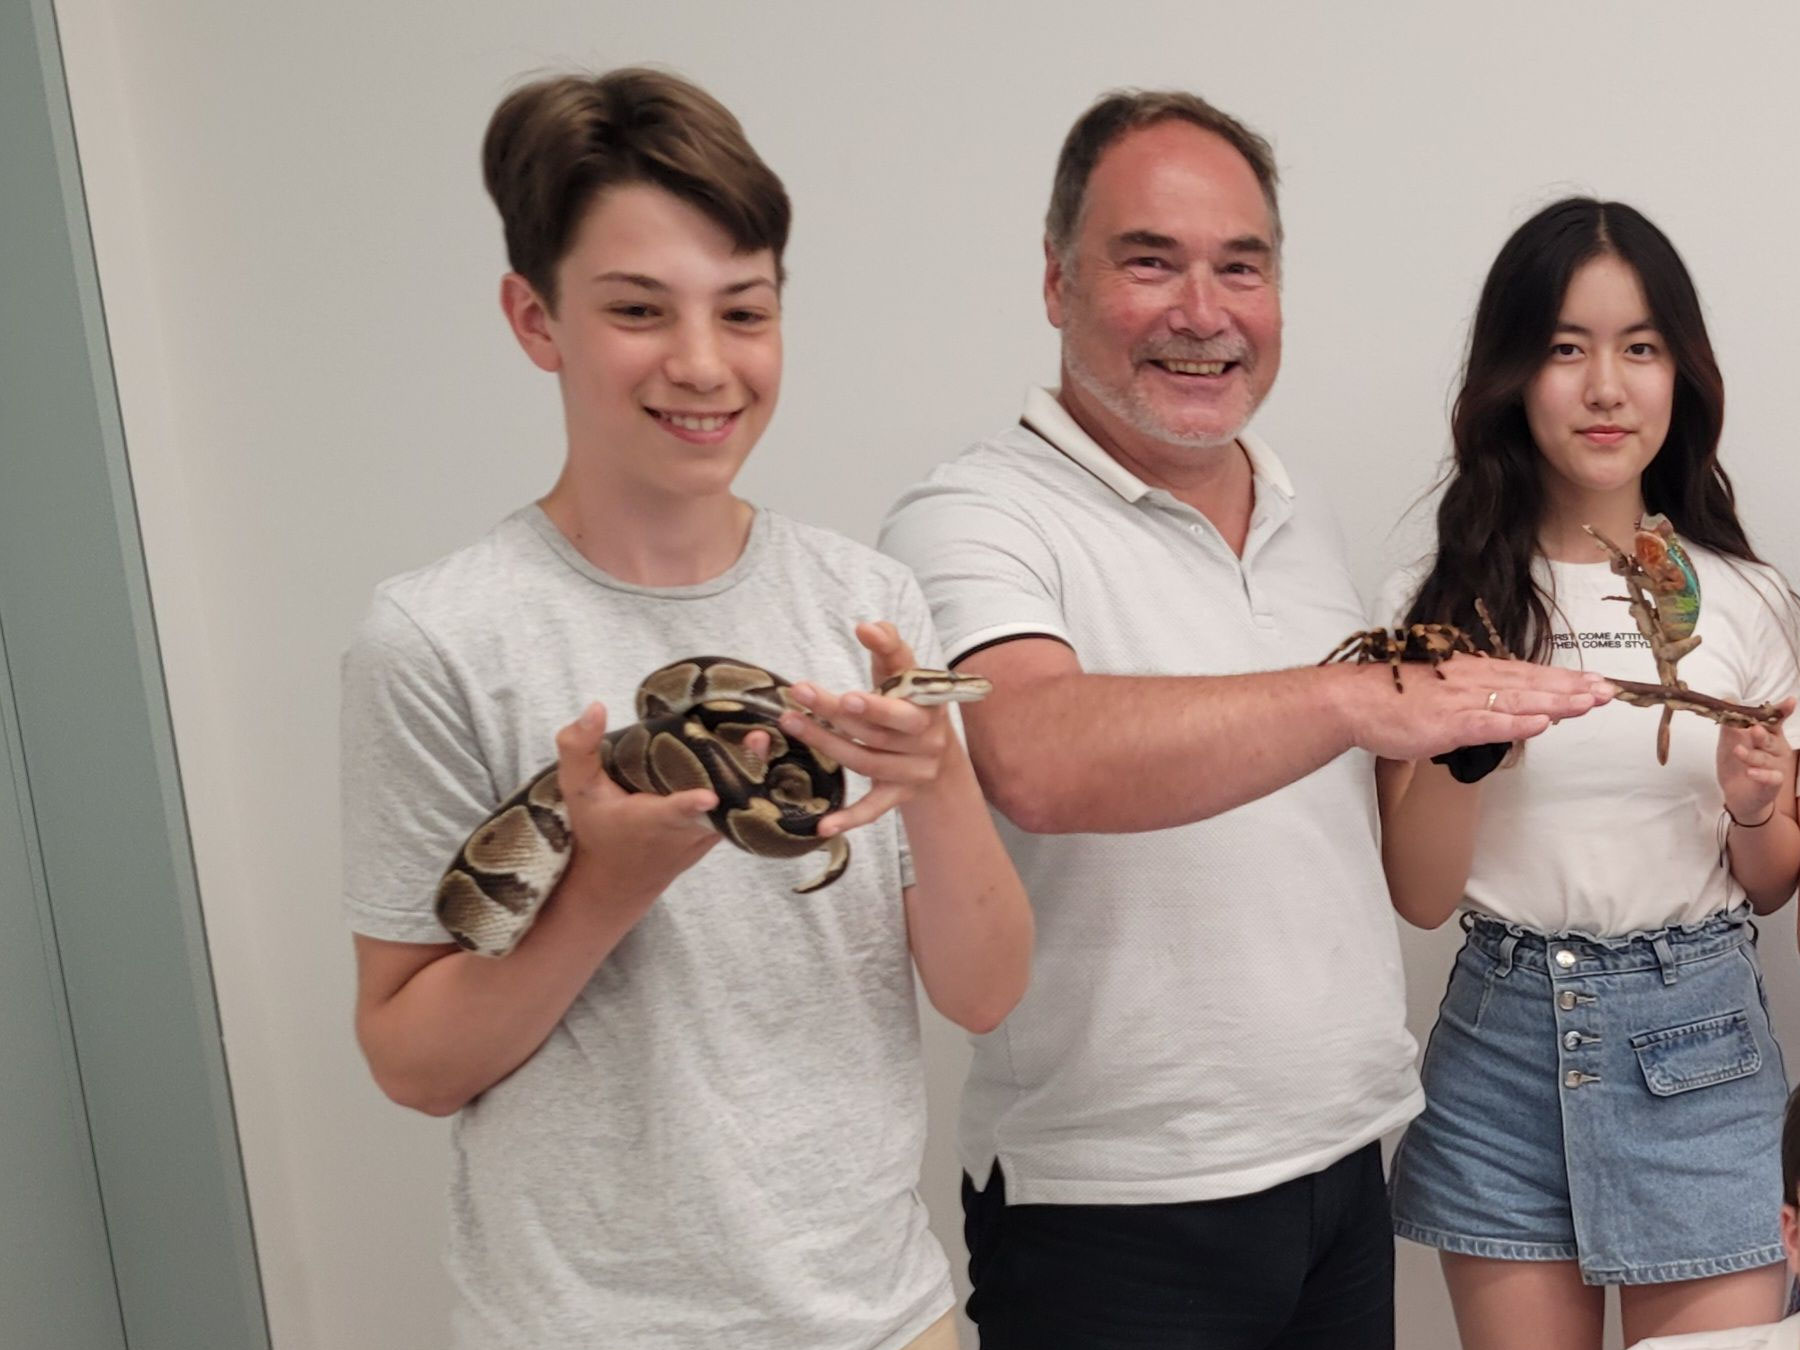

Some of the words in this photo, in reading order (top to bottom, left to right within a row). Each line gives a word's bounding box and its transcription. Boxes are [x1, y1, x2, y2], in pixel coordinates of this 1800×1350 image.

[1578, 632, 1611, 641] COME
[1614, 632, 1642, 640] ATTIT
[1552, 641, 1579, 649] THEN
[1582, 640, 1622, 649] COMES
[1625, 640, 1652, 649] STYL
